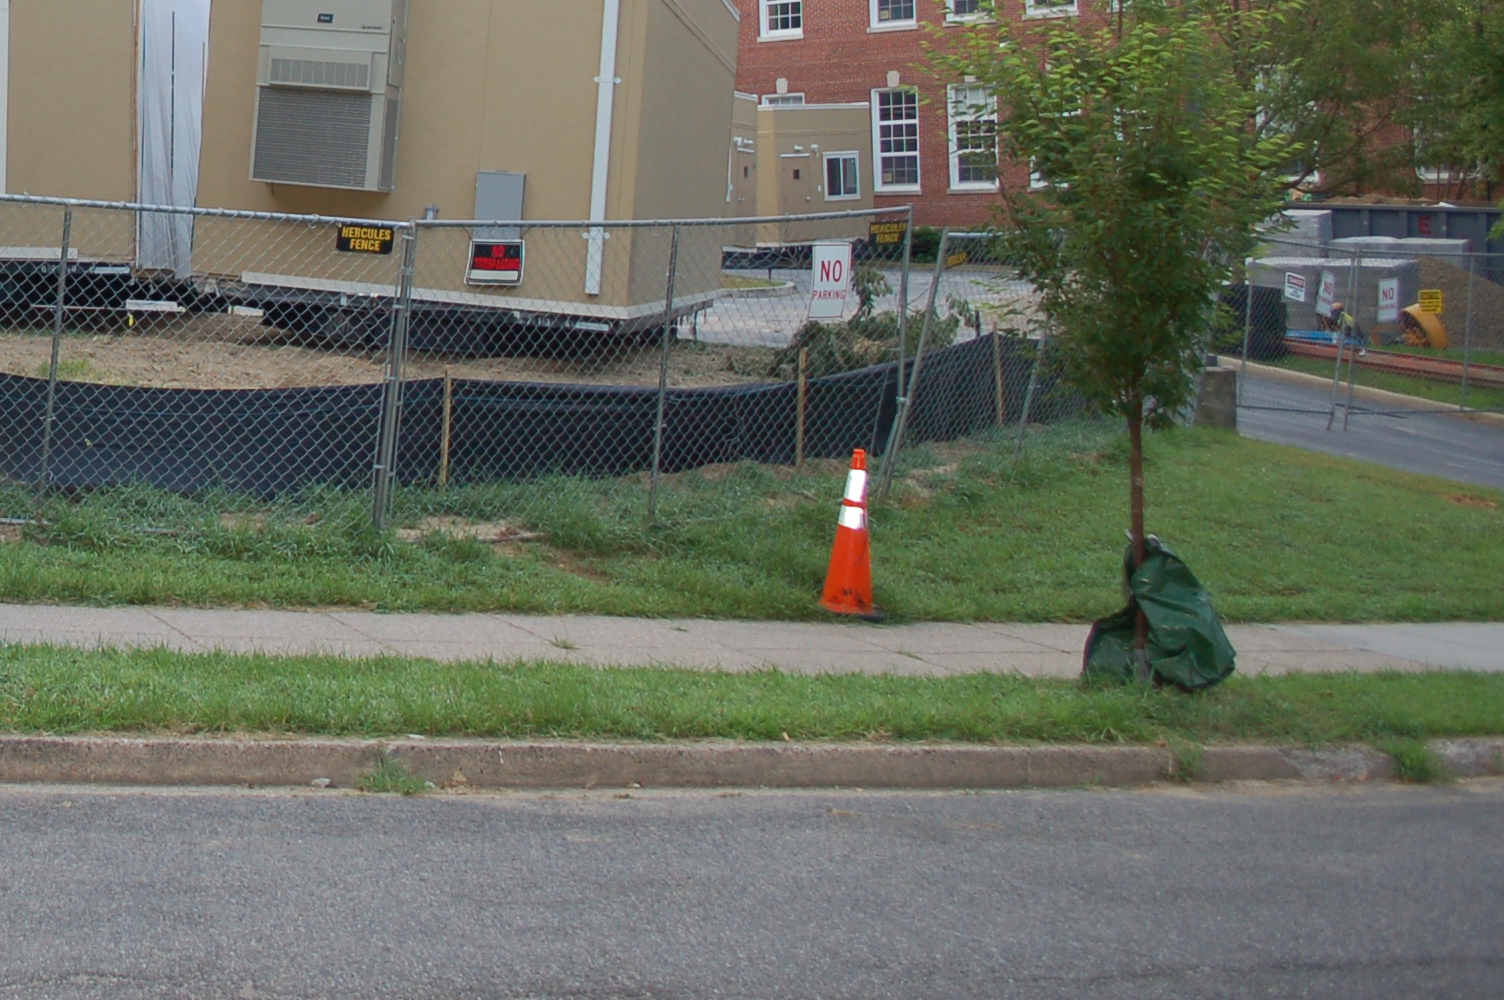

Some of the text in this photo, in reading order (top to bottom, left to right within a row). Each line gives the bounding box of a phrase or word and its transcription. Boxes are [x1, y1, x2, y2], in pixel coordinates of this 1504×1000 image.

[341, 226, 391, 241] HERCULES
[349, 238, 381, 251] FENCE
[820, 259, 843, 282] NO
[812, 289, 846, 300] PARKING
[1381, 287, 1394, 301] NO
